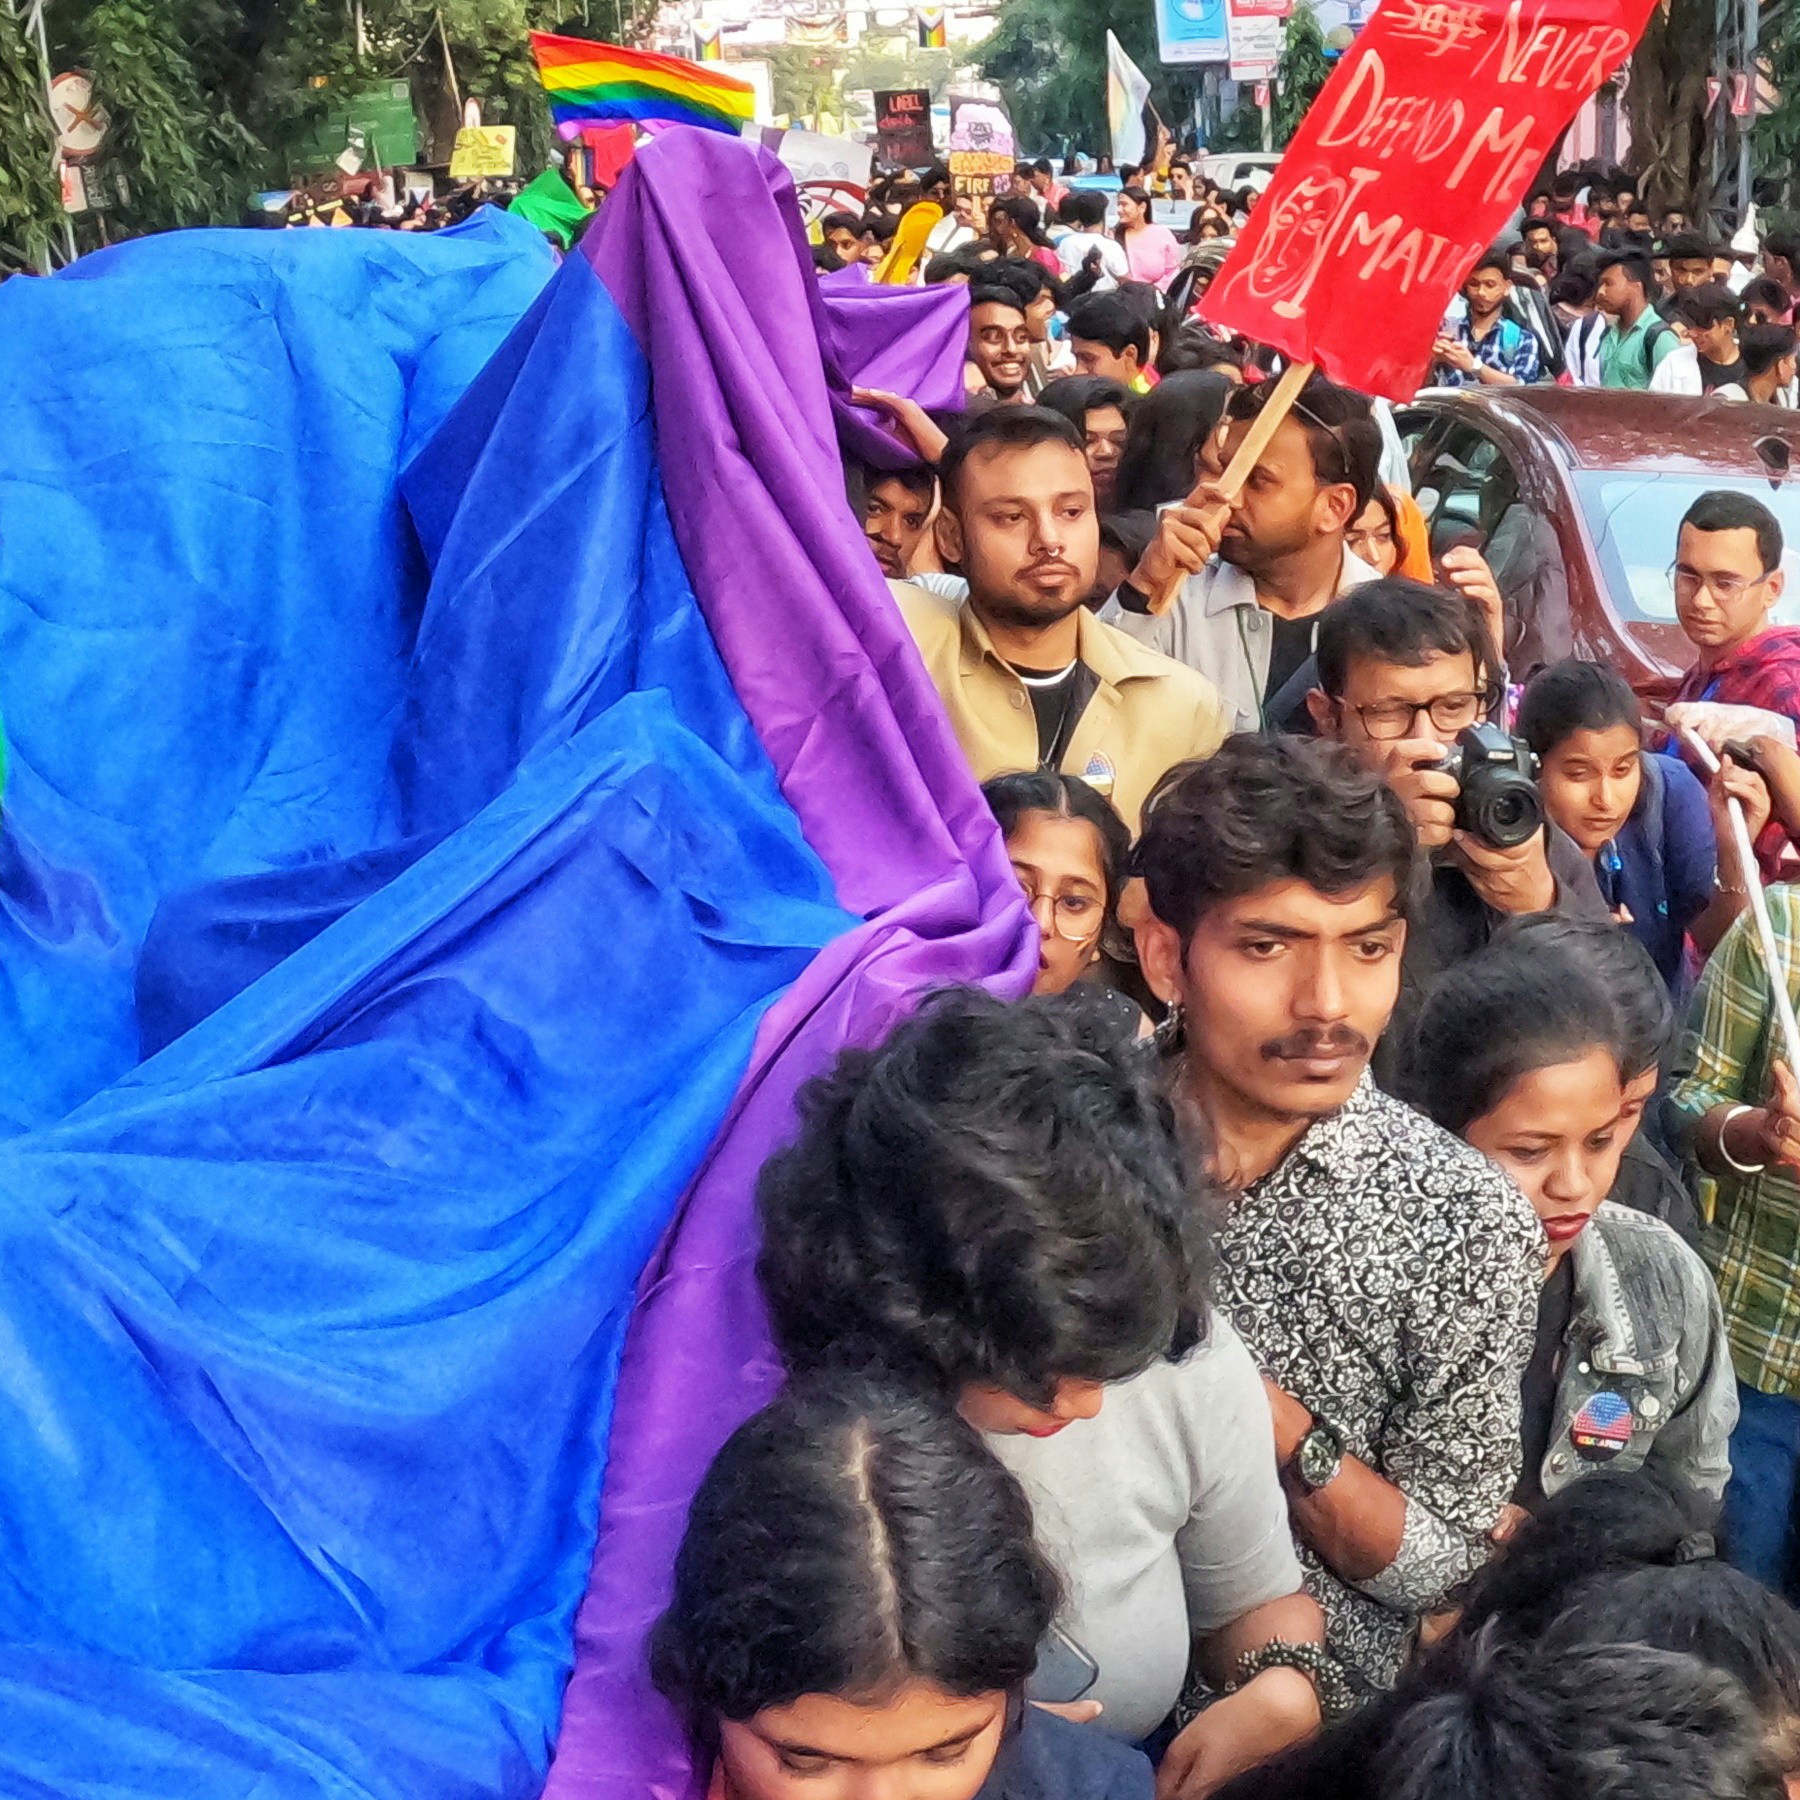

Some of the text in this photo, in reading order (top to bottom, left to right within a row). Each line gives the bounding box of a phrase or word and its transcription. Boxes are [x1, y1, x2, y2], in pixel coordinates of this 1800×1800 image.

[1469, 0, 1630, 92] NEVER
[1318, 48, 1542, 203] DEFEND ME
